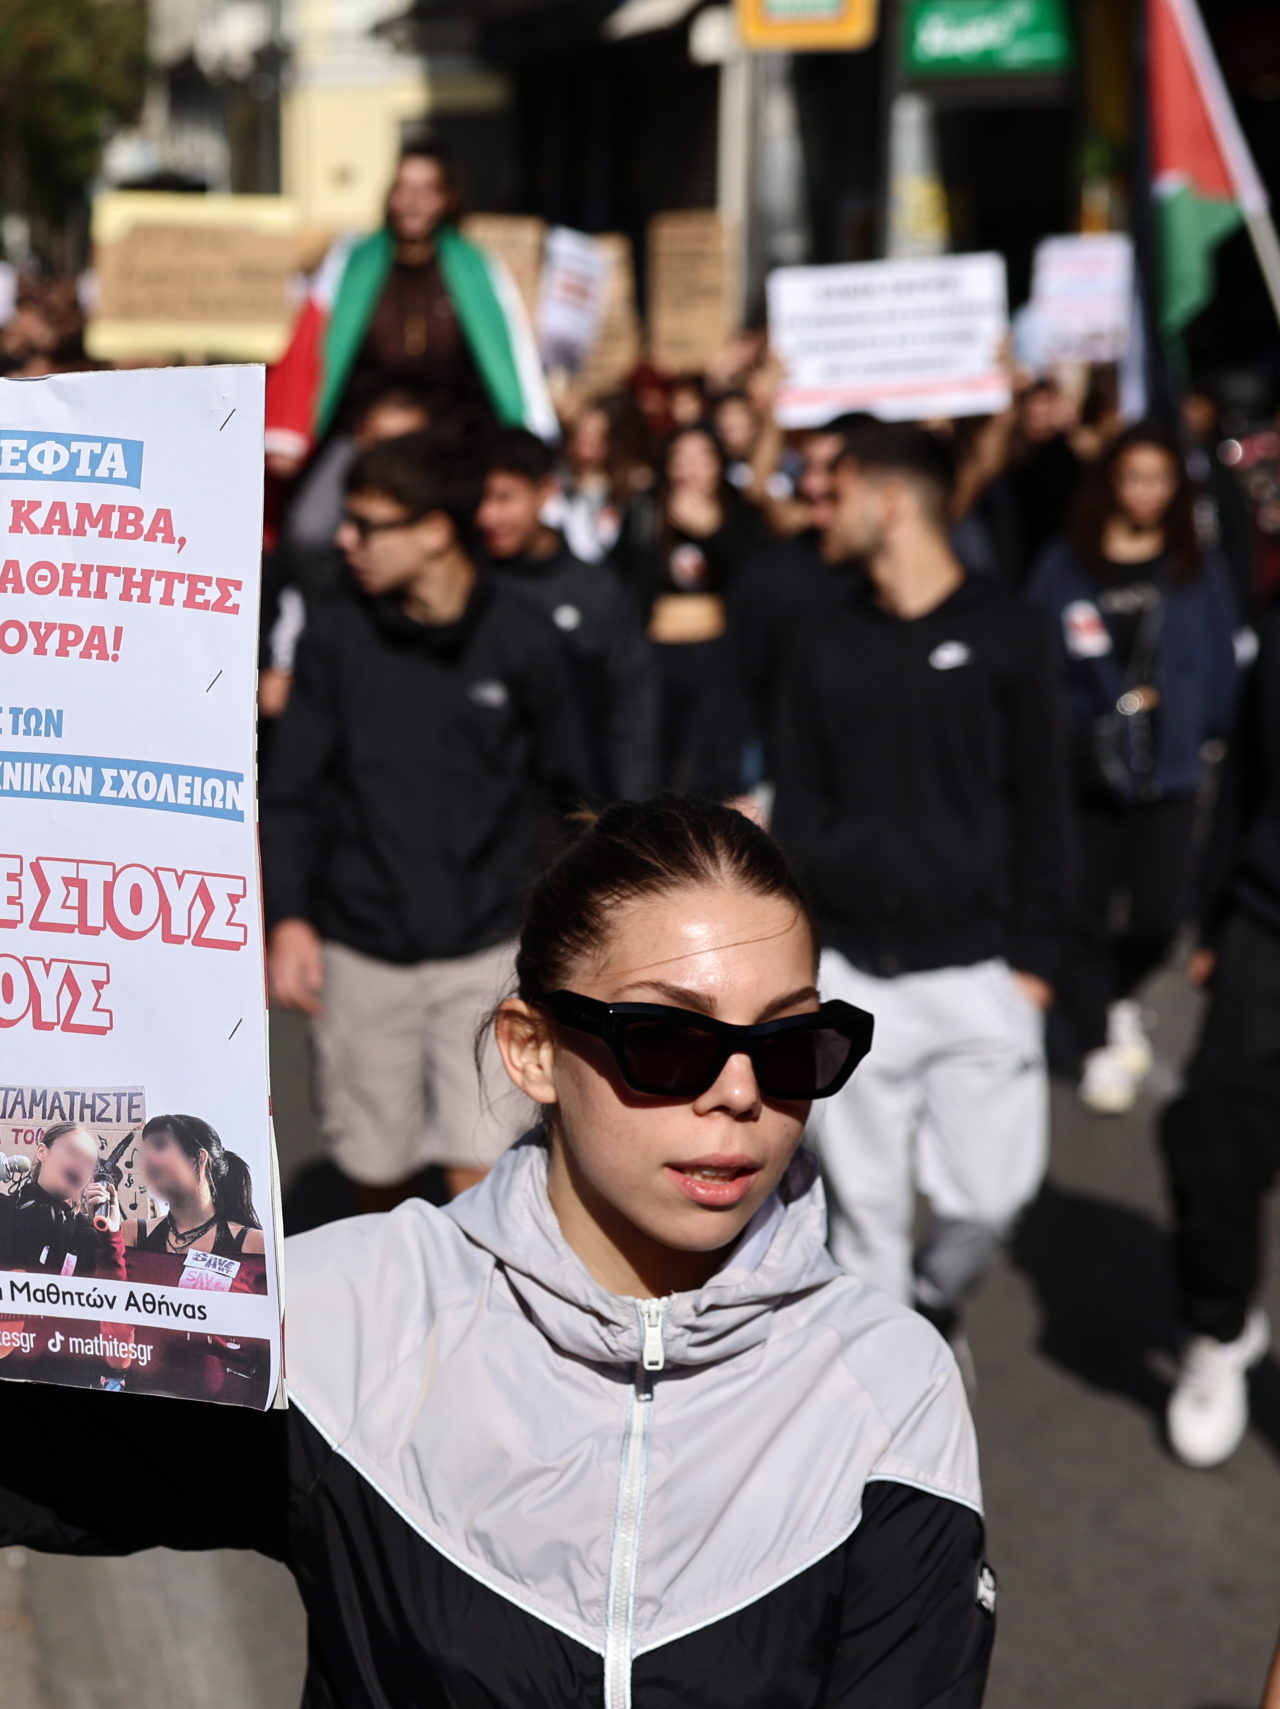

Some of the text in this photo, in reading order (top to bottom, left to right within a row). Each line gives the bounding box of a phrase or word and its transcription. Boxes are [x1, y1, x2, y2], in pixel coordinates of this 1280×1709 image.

[8, 499, 187, 554] ΚΑΜΒΑ,
[9, 707, 64, 738] ΤΩΝ
[100, 767, 244, 812] ΣΧΟΛΕΙΩΝ
[28, 856, 248, 951] ΣΤΟΥΣ
[9, 1280, 117, 1311] Μαθητών
[124, 1290, 208, 1321] Αθήνας
[69, 1334, 154, 1366] mathitesgr
